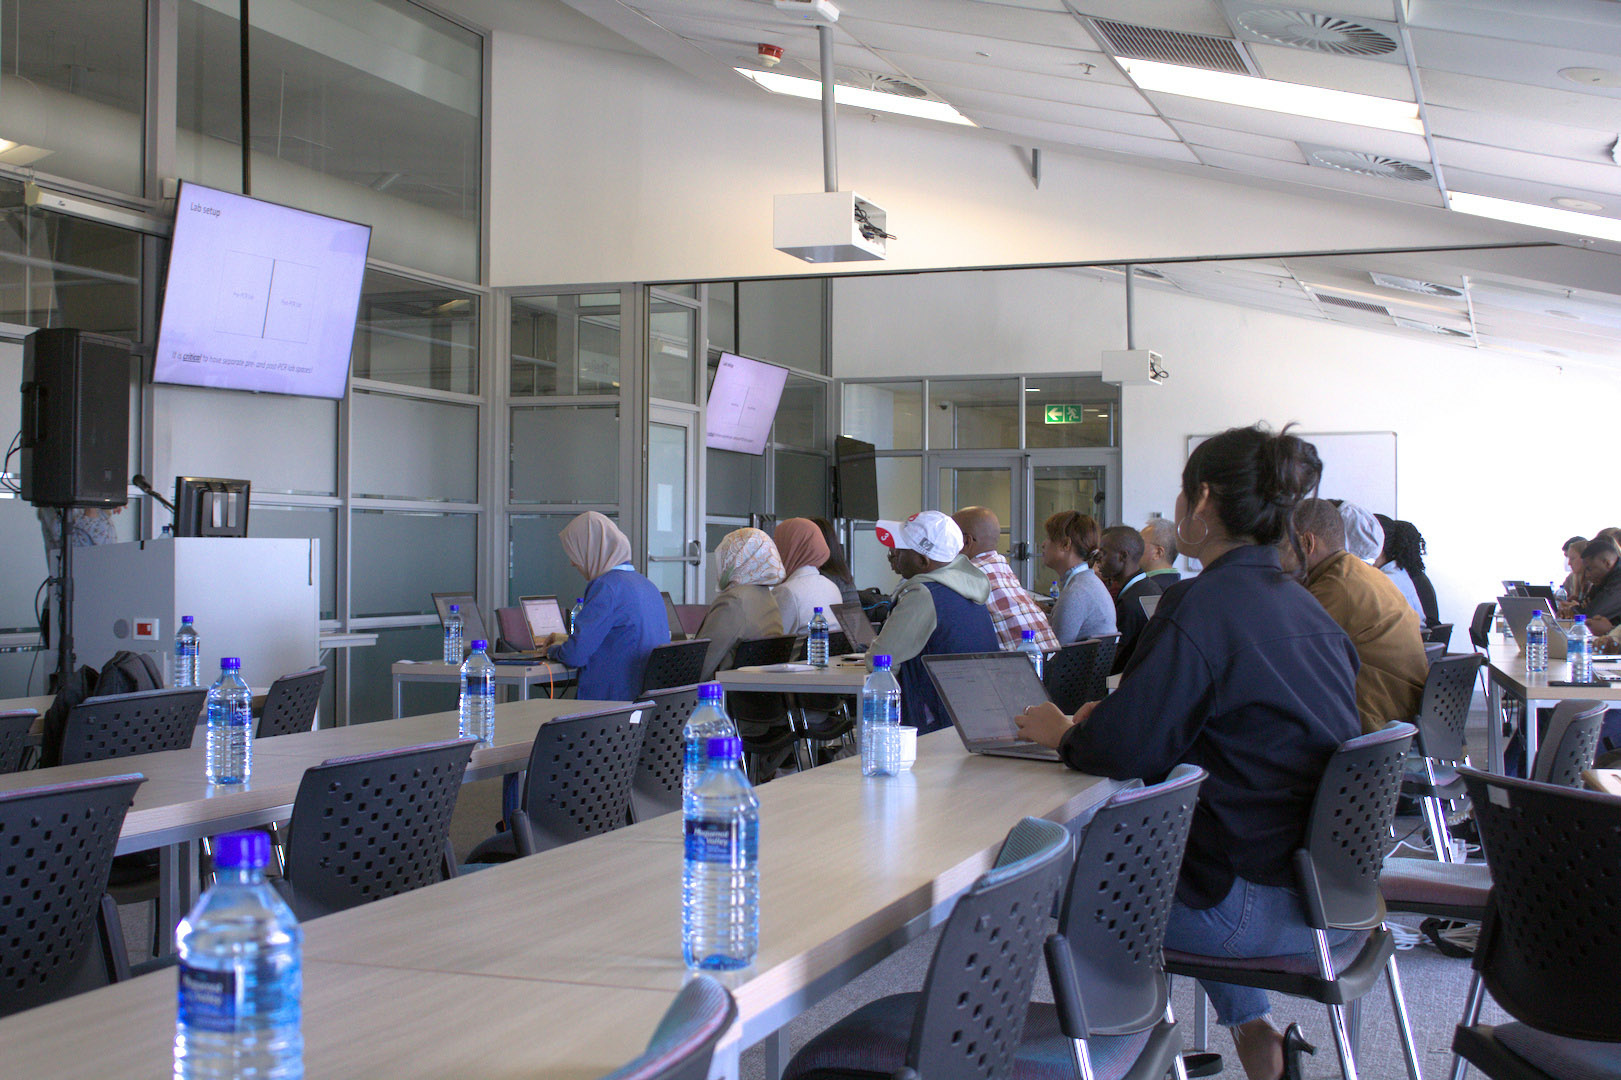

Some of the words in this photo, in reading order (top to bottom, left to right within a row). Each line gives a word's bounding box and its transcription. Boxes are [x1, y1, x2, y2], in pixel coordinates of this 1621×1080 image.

[190, 201, 202, 213] Lab
[203, 205, 221, 218] setup
[183, 352, 202, 362] critical
[203, 354, 208, 362] to
[222, 358, 244, 366] separate
[256, 361, 266, 369] and
[706, 837, 728, 847] Valley
